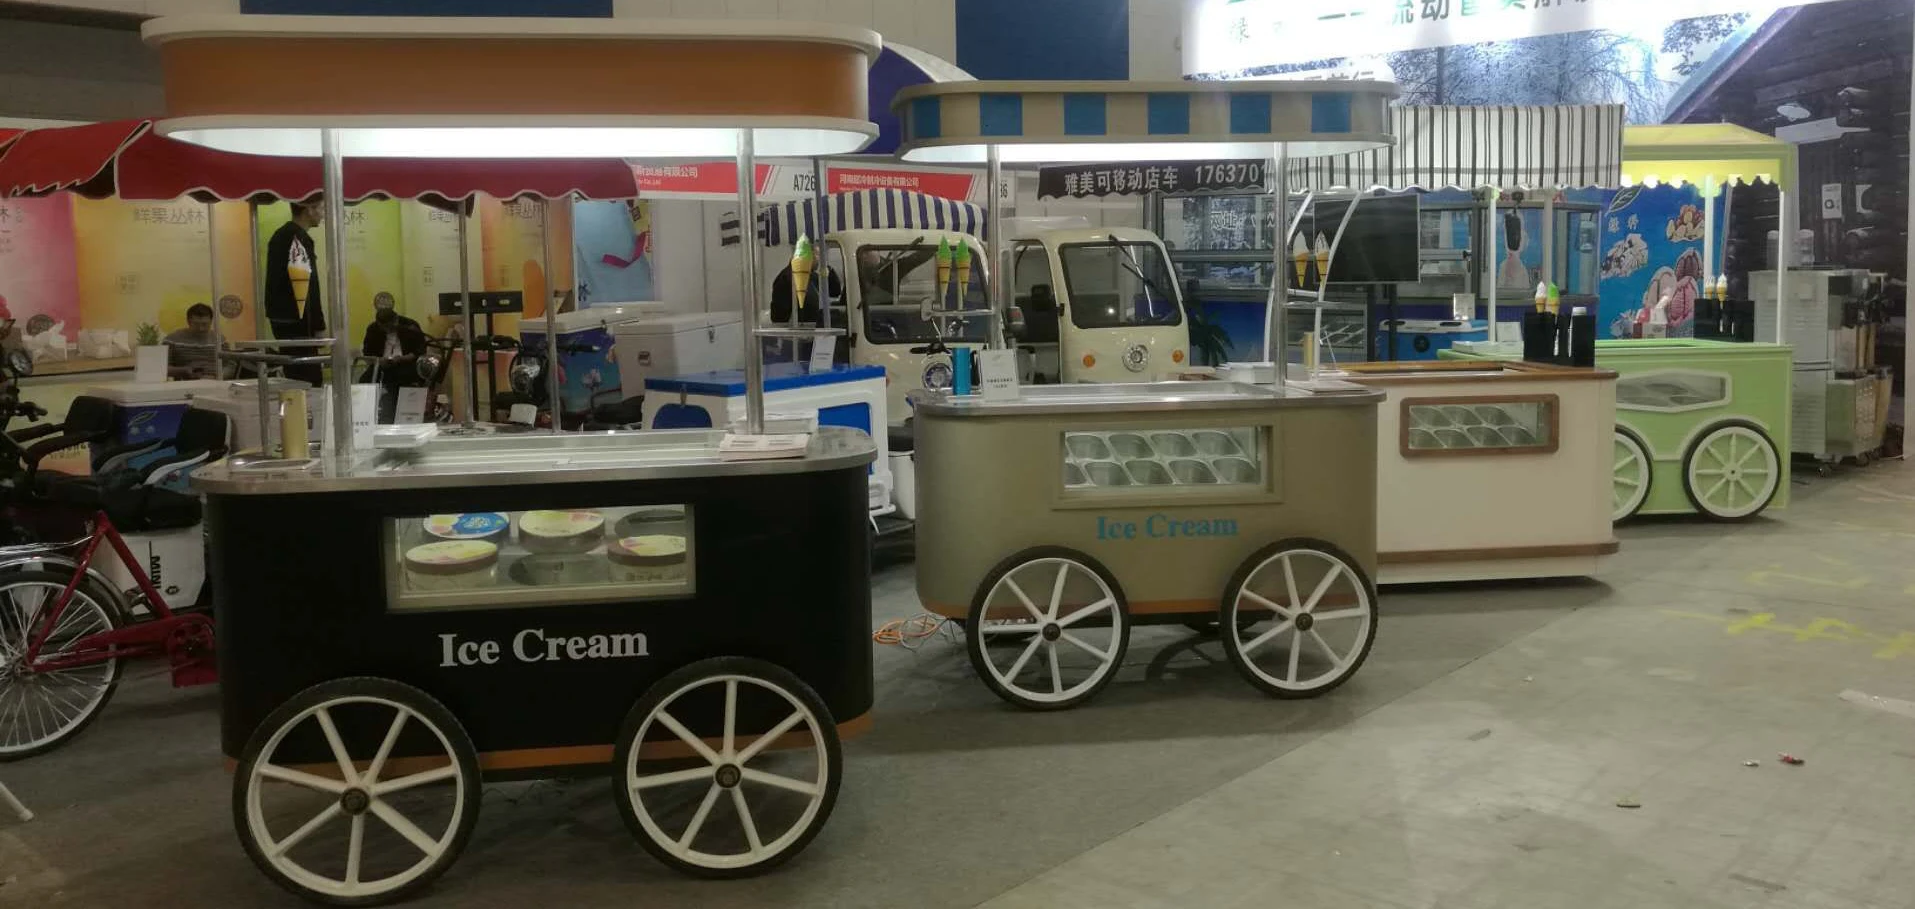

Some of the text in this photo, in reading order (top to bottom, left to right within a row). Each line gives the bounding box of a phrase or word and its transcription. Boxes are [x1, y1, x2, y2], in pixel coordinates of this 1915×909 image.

[1064, 166, 1179, 194] 雅美可移动店车
[1095, 513, 1239, 540] Ice Cream
[438, 628, 649, 667] Ice Cream
